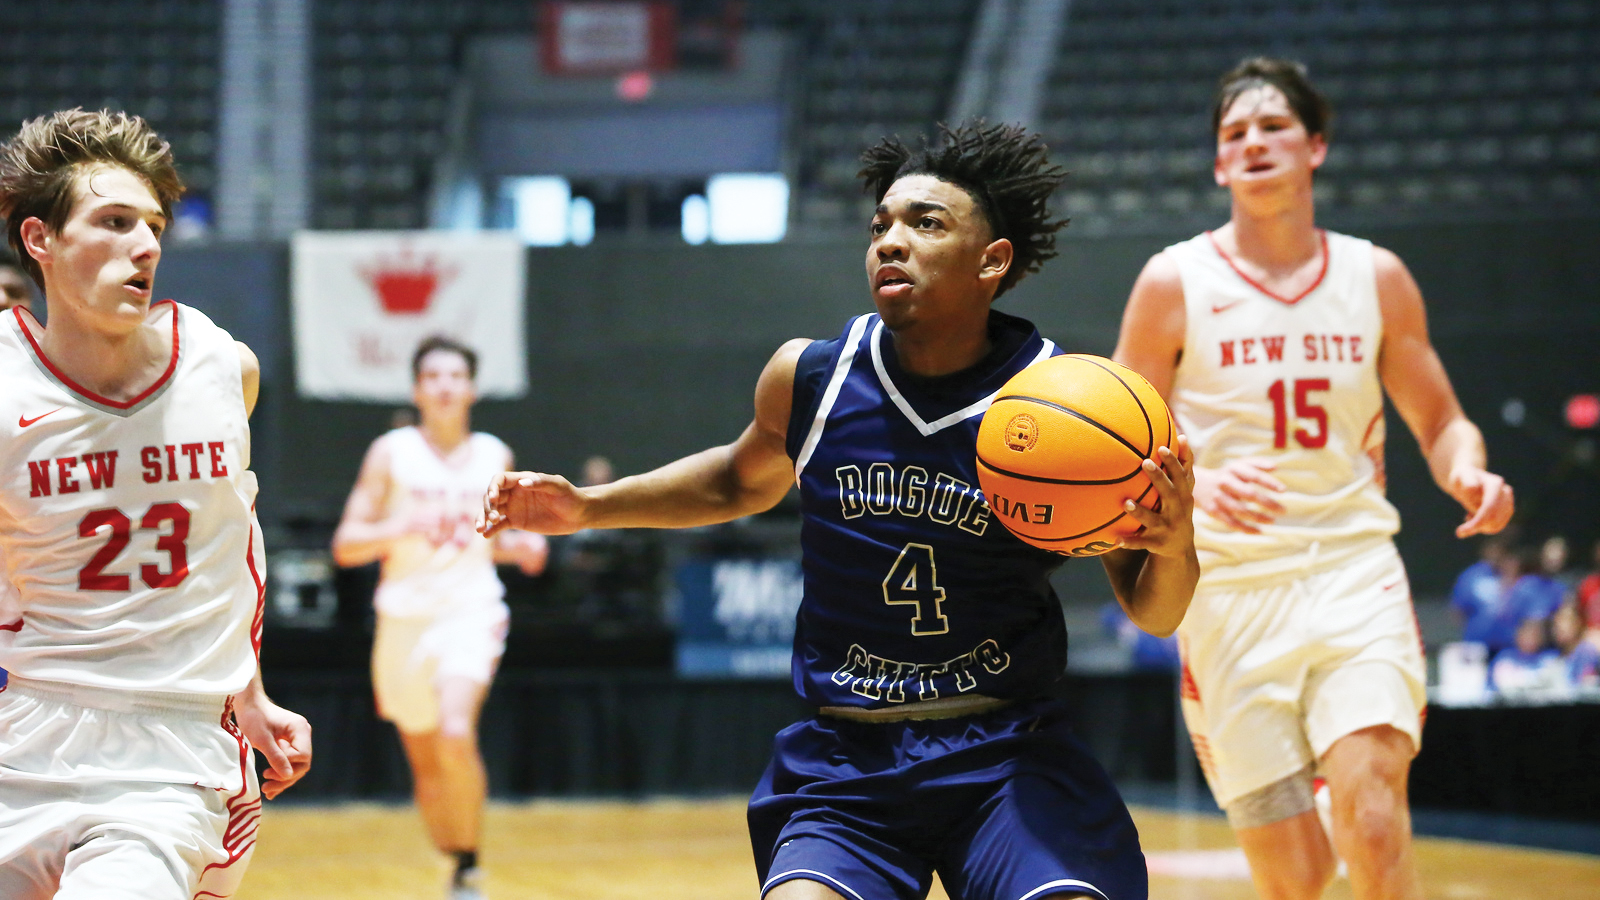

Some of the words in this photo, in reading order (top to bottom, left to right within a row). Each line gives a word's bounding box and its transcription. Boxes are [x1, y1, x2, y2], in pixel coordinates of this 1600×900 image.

[1220, 335, 1286, 369] NEW
[1303, 333, 1364, 363] SITE
[1266, 377, 1331, 449] 15
[27, 450, 119, 498] NEW
[141, 441, 229, 484] SITE
[836, 462, 992, 537] BOGUE
[76, 500, 192, 592] 23
[882, 542, 949, 636] 4
[831, 638, 1011, 703] CHITTO
